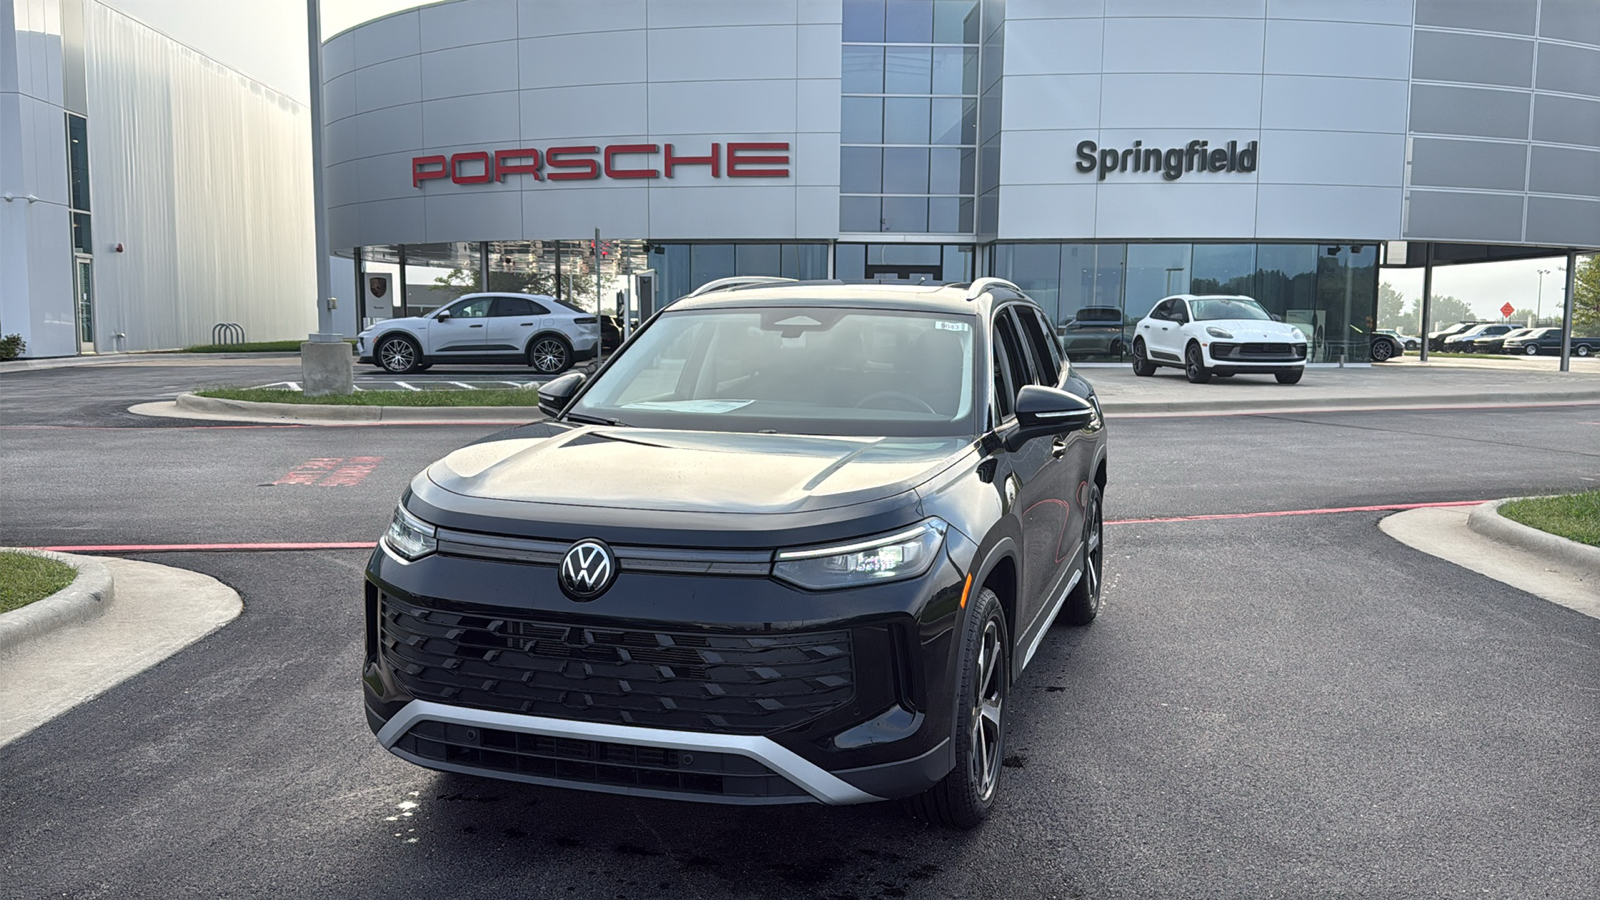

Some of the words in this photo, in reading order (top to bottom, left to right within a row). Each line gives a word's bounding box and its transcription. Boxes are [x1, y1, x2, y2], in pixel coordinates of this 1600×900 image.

[412, 142, 790, 188] PORSCHE
[1075, 140, 1258, 181] Springfield
[562, 542, 611, 592] VW
